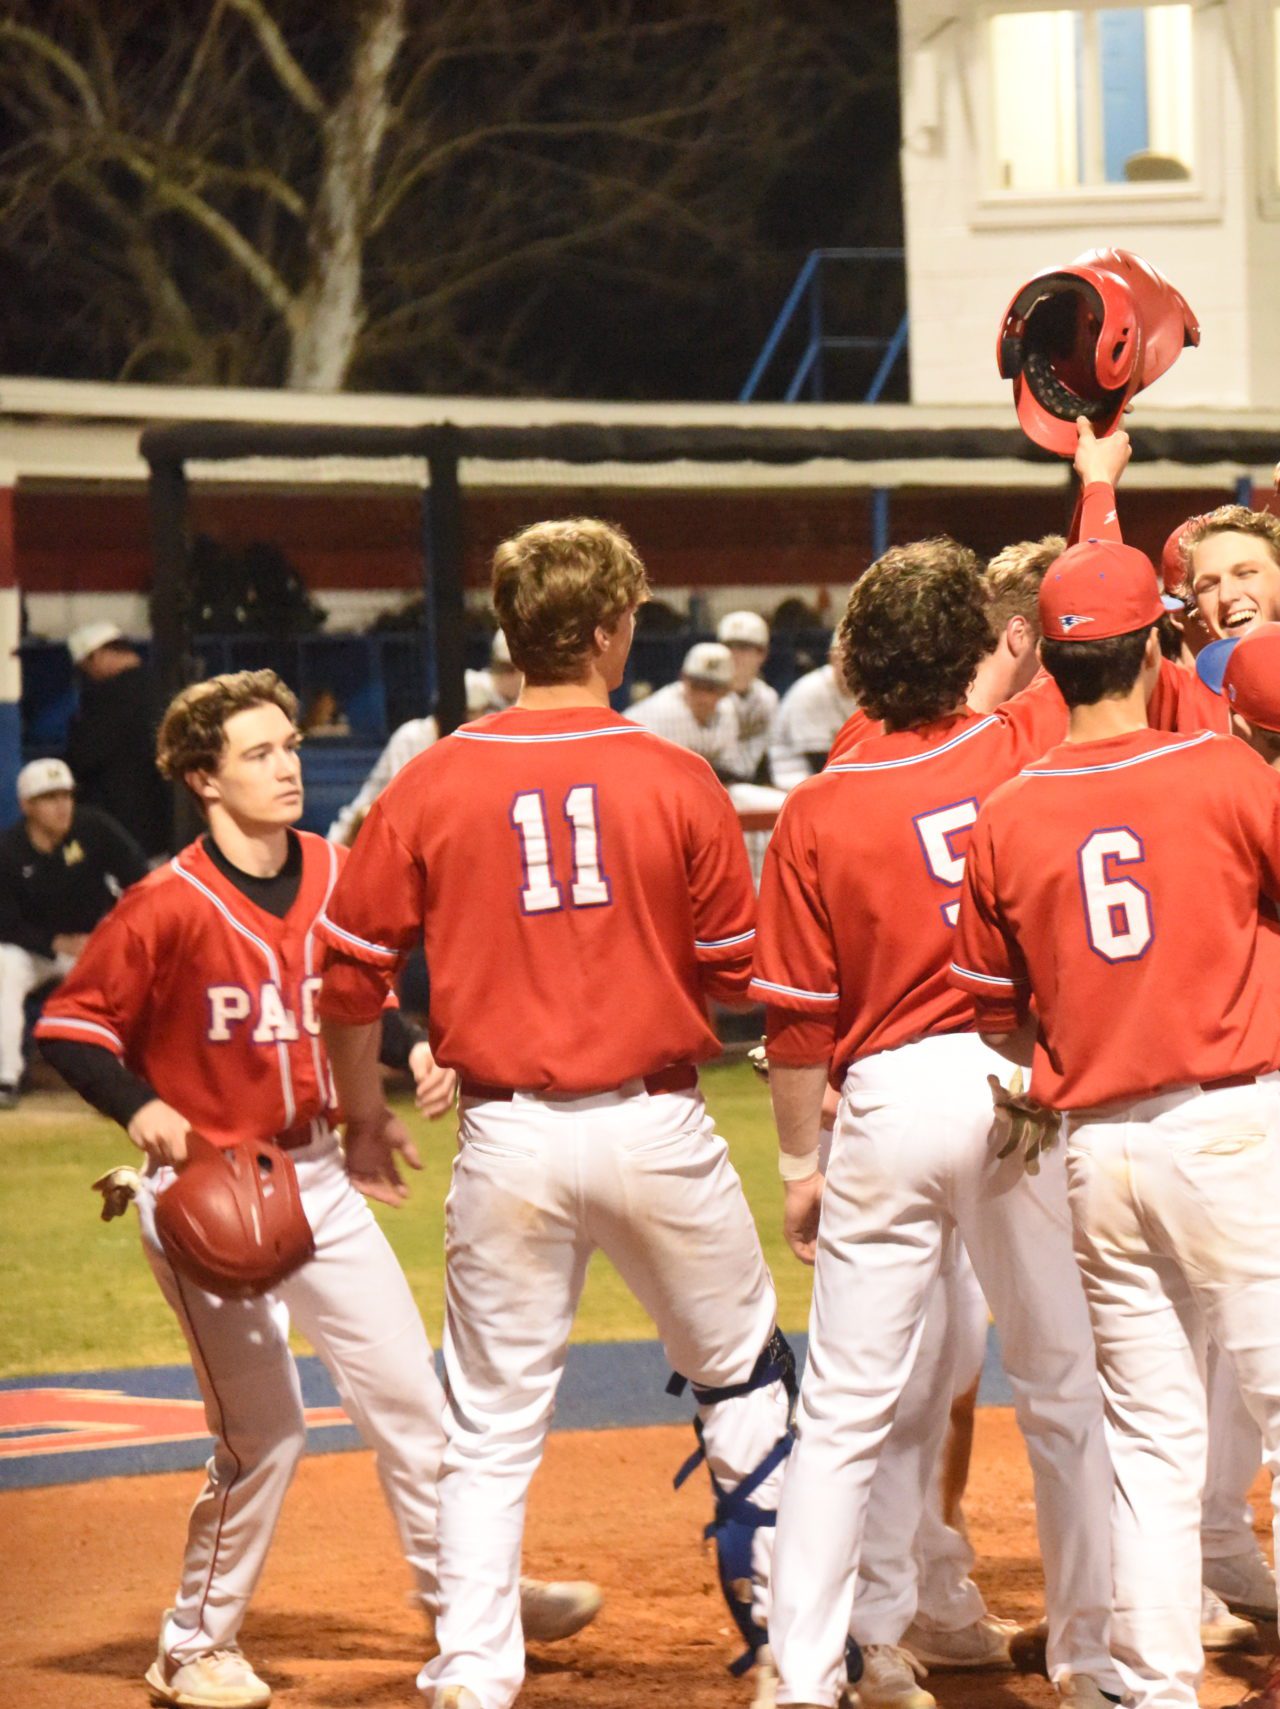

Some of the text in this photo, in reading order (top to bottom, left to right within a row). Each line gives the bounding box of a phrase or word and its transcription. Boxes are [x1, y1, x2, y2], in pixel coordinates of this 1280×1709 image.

[508, 784, 612, 916] 11
[1077, 826, 1155, 965] 6
[206, 976, 322, 1043] PAC
